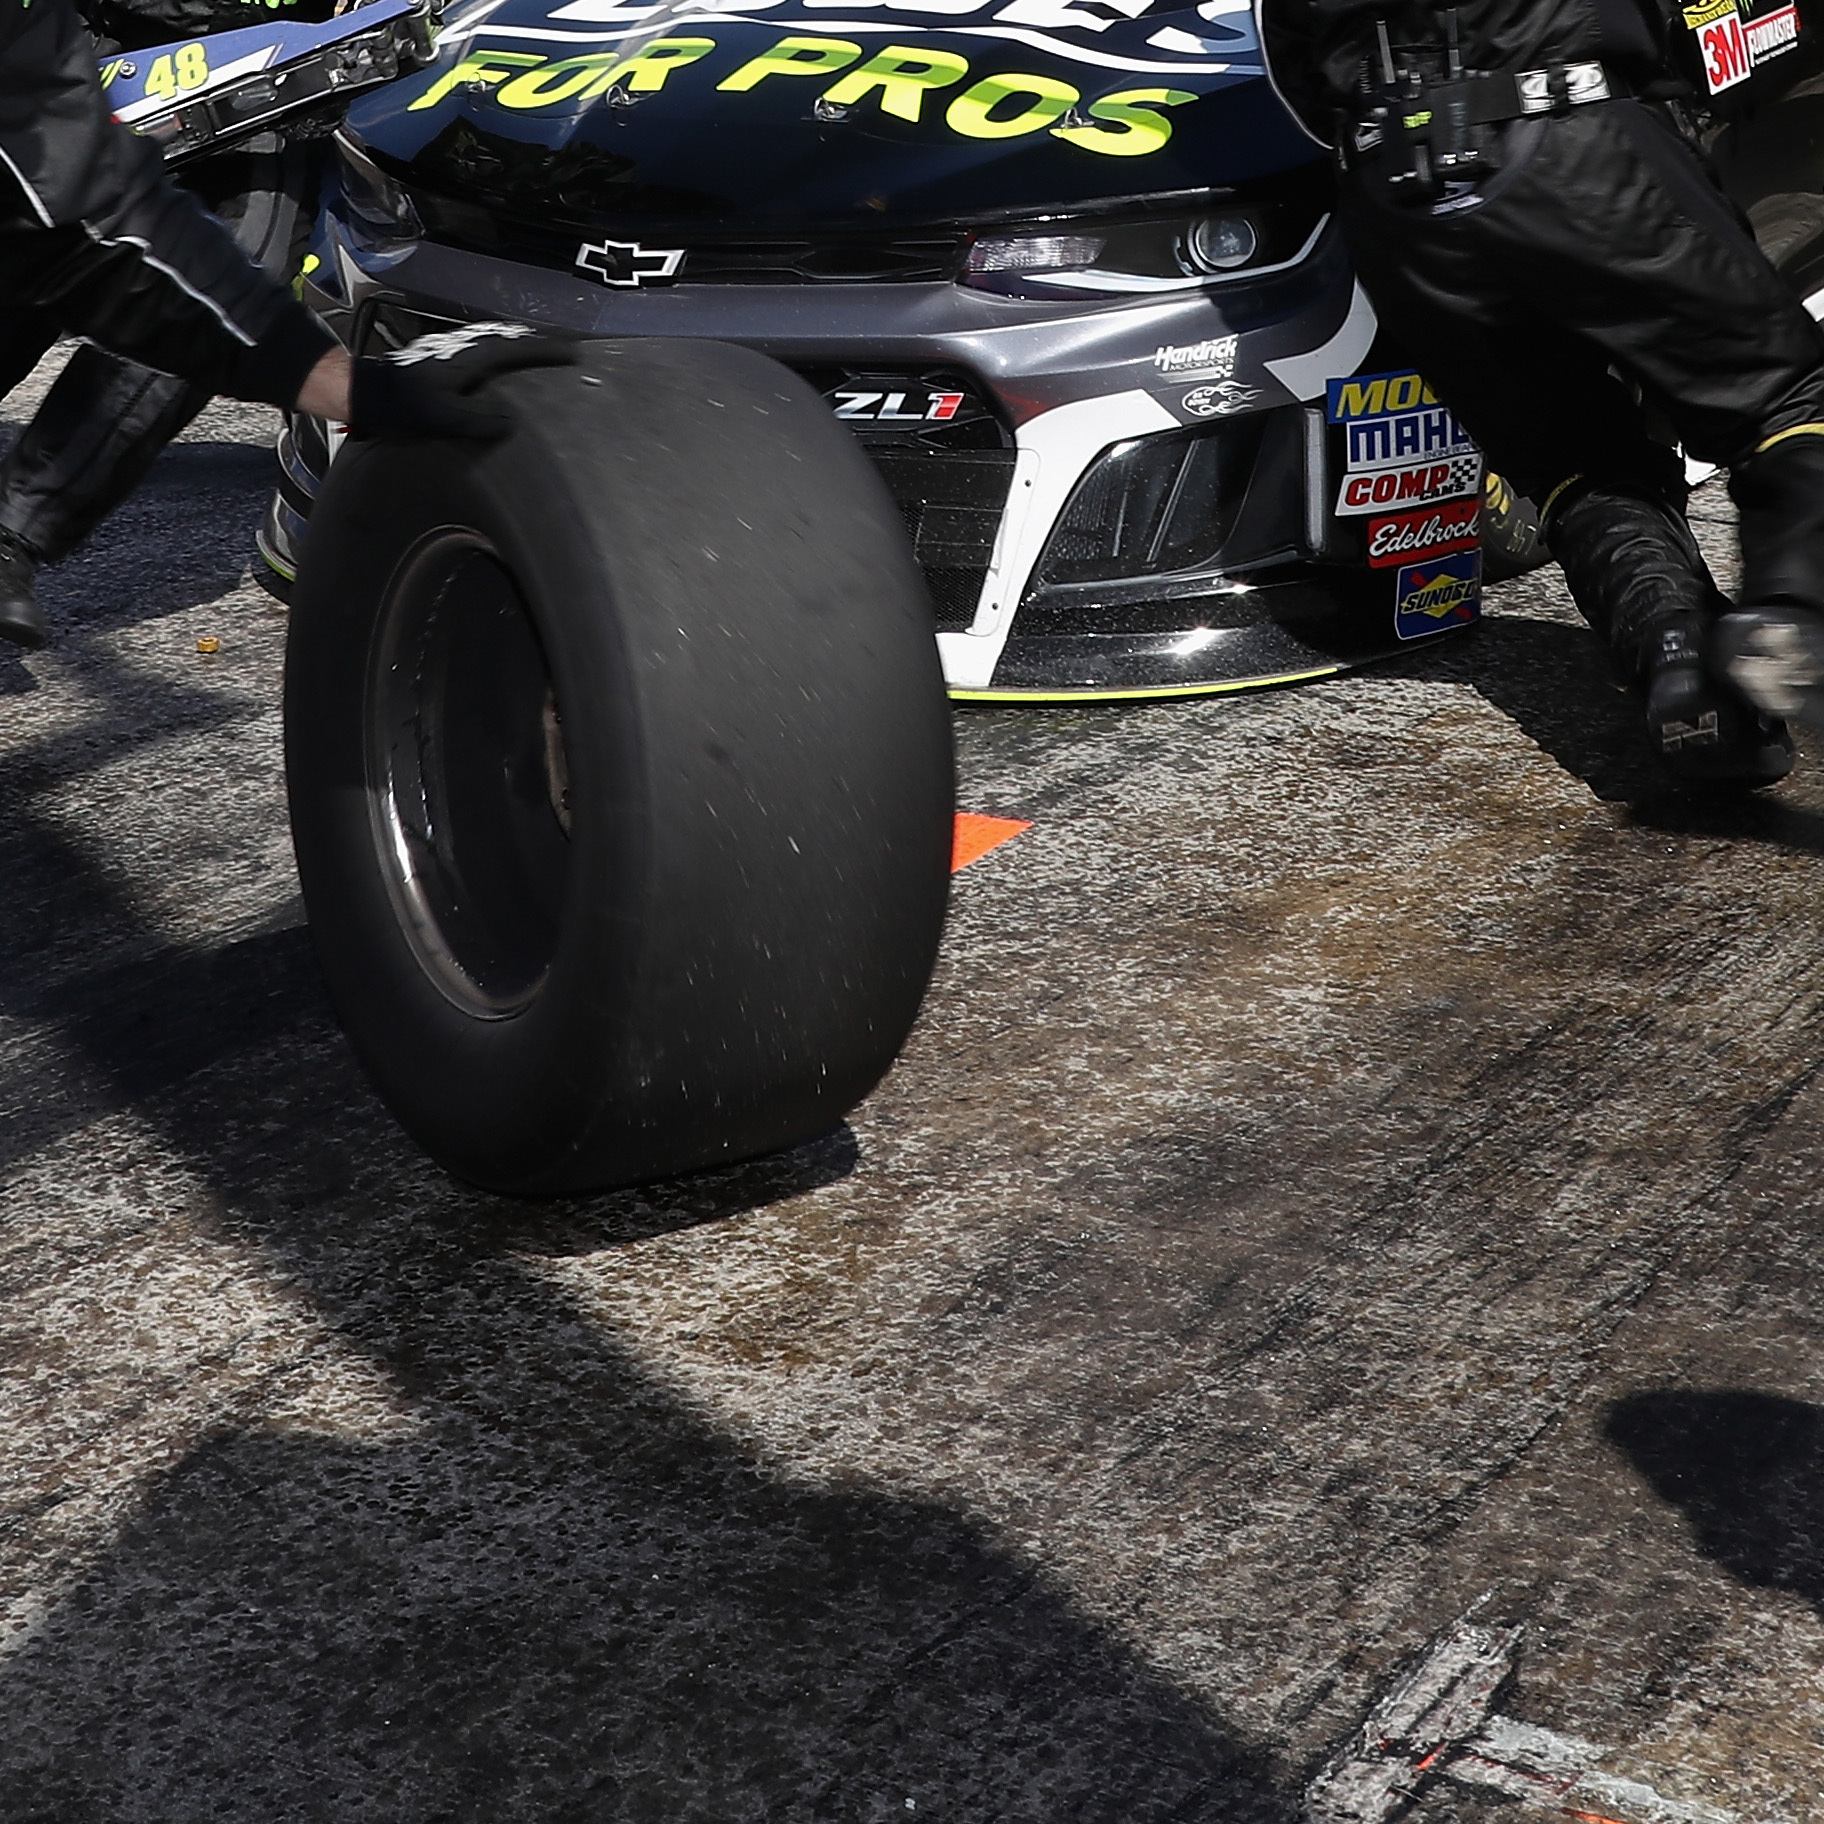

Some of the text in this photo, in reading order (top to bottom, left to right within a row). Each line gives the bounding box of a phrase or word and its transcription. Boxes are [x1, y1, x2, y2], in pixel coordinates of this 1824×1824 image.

[143, 42, 210, 101] 48
[1703, 18, 1749, 88] 3M
[407, 37, 1200, 157] FOR PROS
[1154, 333, 1240, 372] Hendrick
[832, 392, 966, 421] ZL1
[1345, 463, 1452, 507] COMP
[1420, 481, 1467, 502] CAMS
[1368, 513, 1481, 558] Edelbrock
